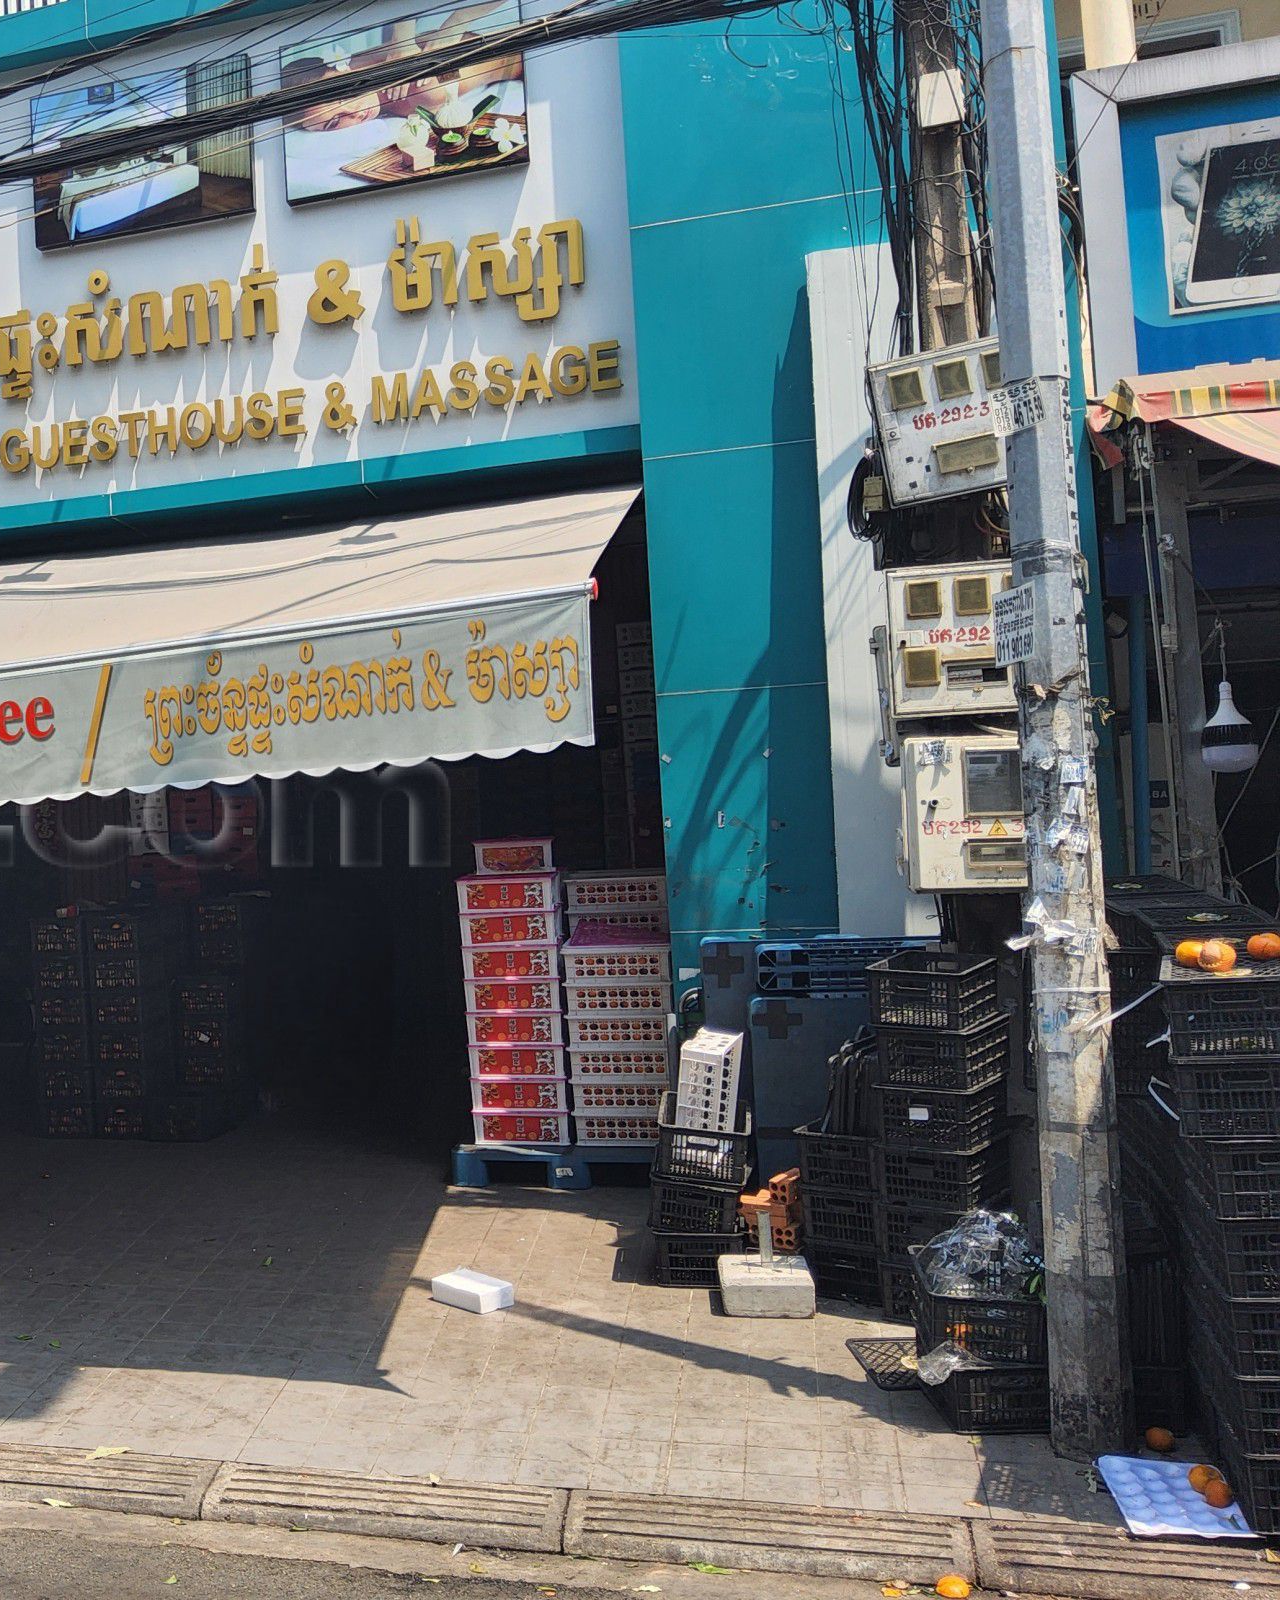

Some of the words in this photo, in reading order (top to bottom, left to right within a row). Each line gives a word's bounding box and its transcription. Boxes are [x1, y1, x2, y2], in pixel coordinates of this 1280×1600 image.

[307, 259, 365, 325] &
[0, 387, 306, 473] GUESTHOUSE
[323, 381, 357, 430] &
[371, 339, 621, 423] MASSAGE
[420, 649, 456, 710] &
